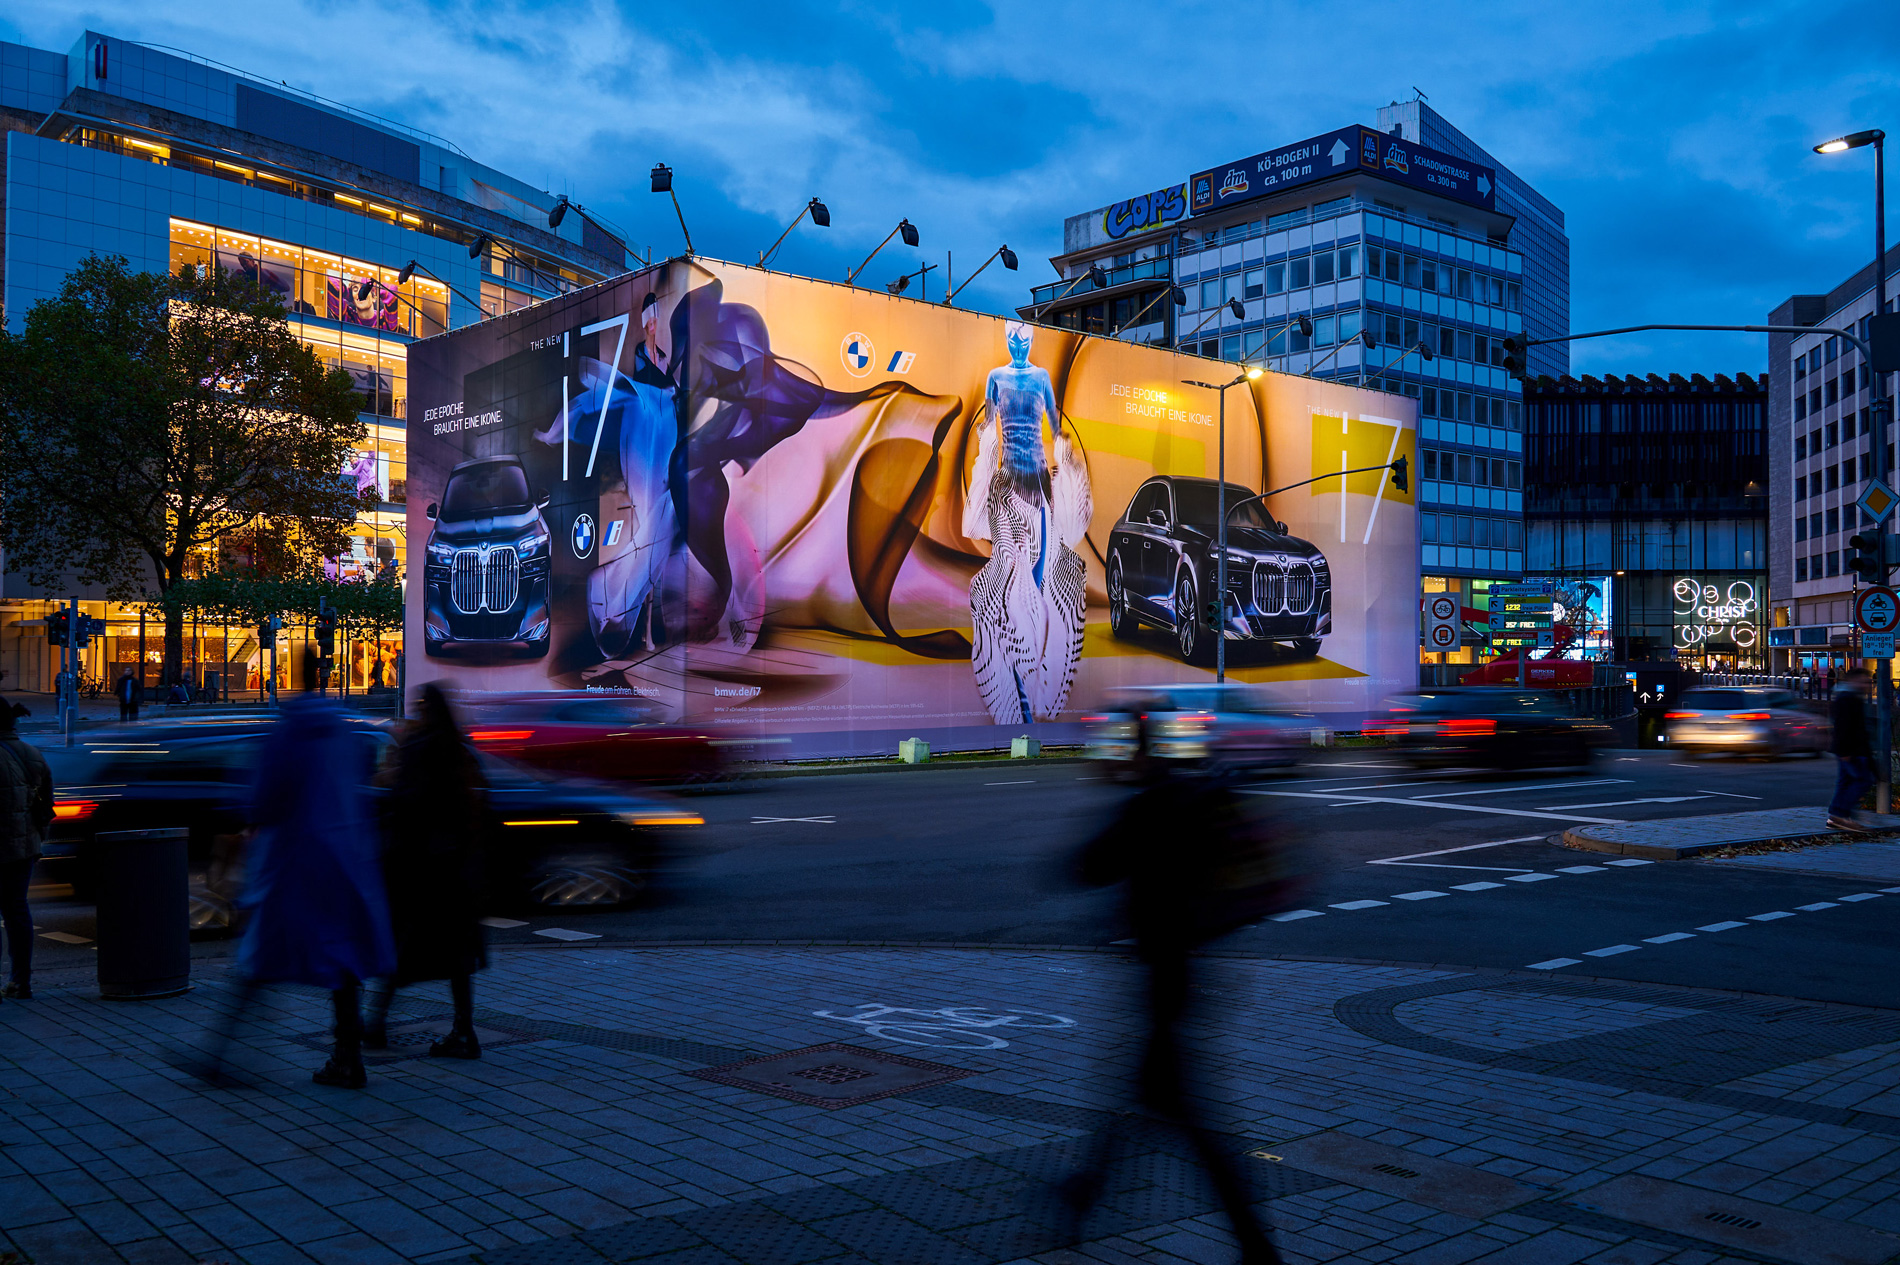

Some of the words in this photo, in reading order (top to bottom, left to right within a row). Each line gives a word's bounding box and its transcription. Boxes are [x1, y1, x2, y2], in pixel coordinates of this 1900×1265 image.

[1257, 147, 1310, 172] KÖ-BOGEN
[1312, 144, 1319, 156] II
[1363, 150, 1377, 160] ALDI
[1388, 143, 1406, 163] dm
[1264, 175, 1278, 186] ca.
[1281, 167, 1299, 182] 100
[1302, 164, 1312, 176] m
[1414, 154, 1470, 181] SCHADOWSTRASSE
[1223, 169, 1247, 189] dm
[1427, 173, 1437, 183] ca.
[1438, 175, 1450, 187] 300
[1451, 181, 1457, 189] m
[1195, 191, 1210, 202] ALDI
[1106, 183, 1187, 239] COPS
[530, 338, 544, 352] THE
[546, 333, 562, 347] NEW
[563, 313, 629, 481] i7
[1109, 383, 1131, 398] JEDE
[1132, 387, 1167, 404] EPOCHE
[423, 407, 438, 423] JEDE
[438, 401, 464, 419] EPOCHE
[1125, 402, 1167, 419] BRAUCHT
[1168, 408, 1187, 423] EINE
[1188, 412, 1215, 427] IKONE.
[1306, 404, 1321, 416] THE
[1323, 408, 1340, 418] NEW
[433, 418, 463, 436] BRAUCHT
[464, 415, 480, 430] EINE
[480, 410, 503, 426] IKONE.
[1340, 411, 1403, 545] i7
[1505, 603, 1521, 611] 1232
[1697, 605, 1746, 618] CHRIST
[1505, 621, 1517, 629] 357
[1519, 621, 1536, 629] FREI
[1492, 638, 1504, 646] 607
[1506, 638, 1522, 646] FREI
[586, 684, 605, 694] Freude
[613, 685, 633, 696] Fahren.
[633, 685, 661, 697] Elektrisch.
[714, 686, 761, 697] bmw.de/i7
